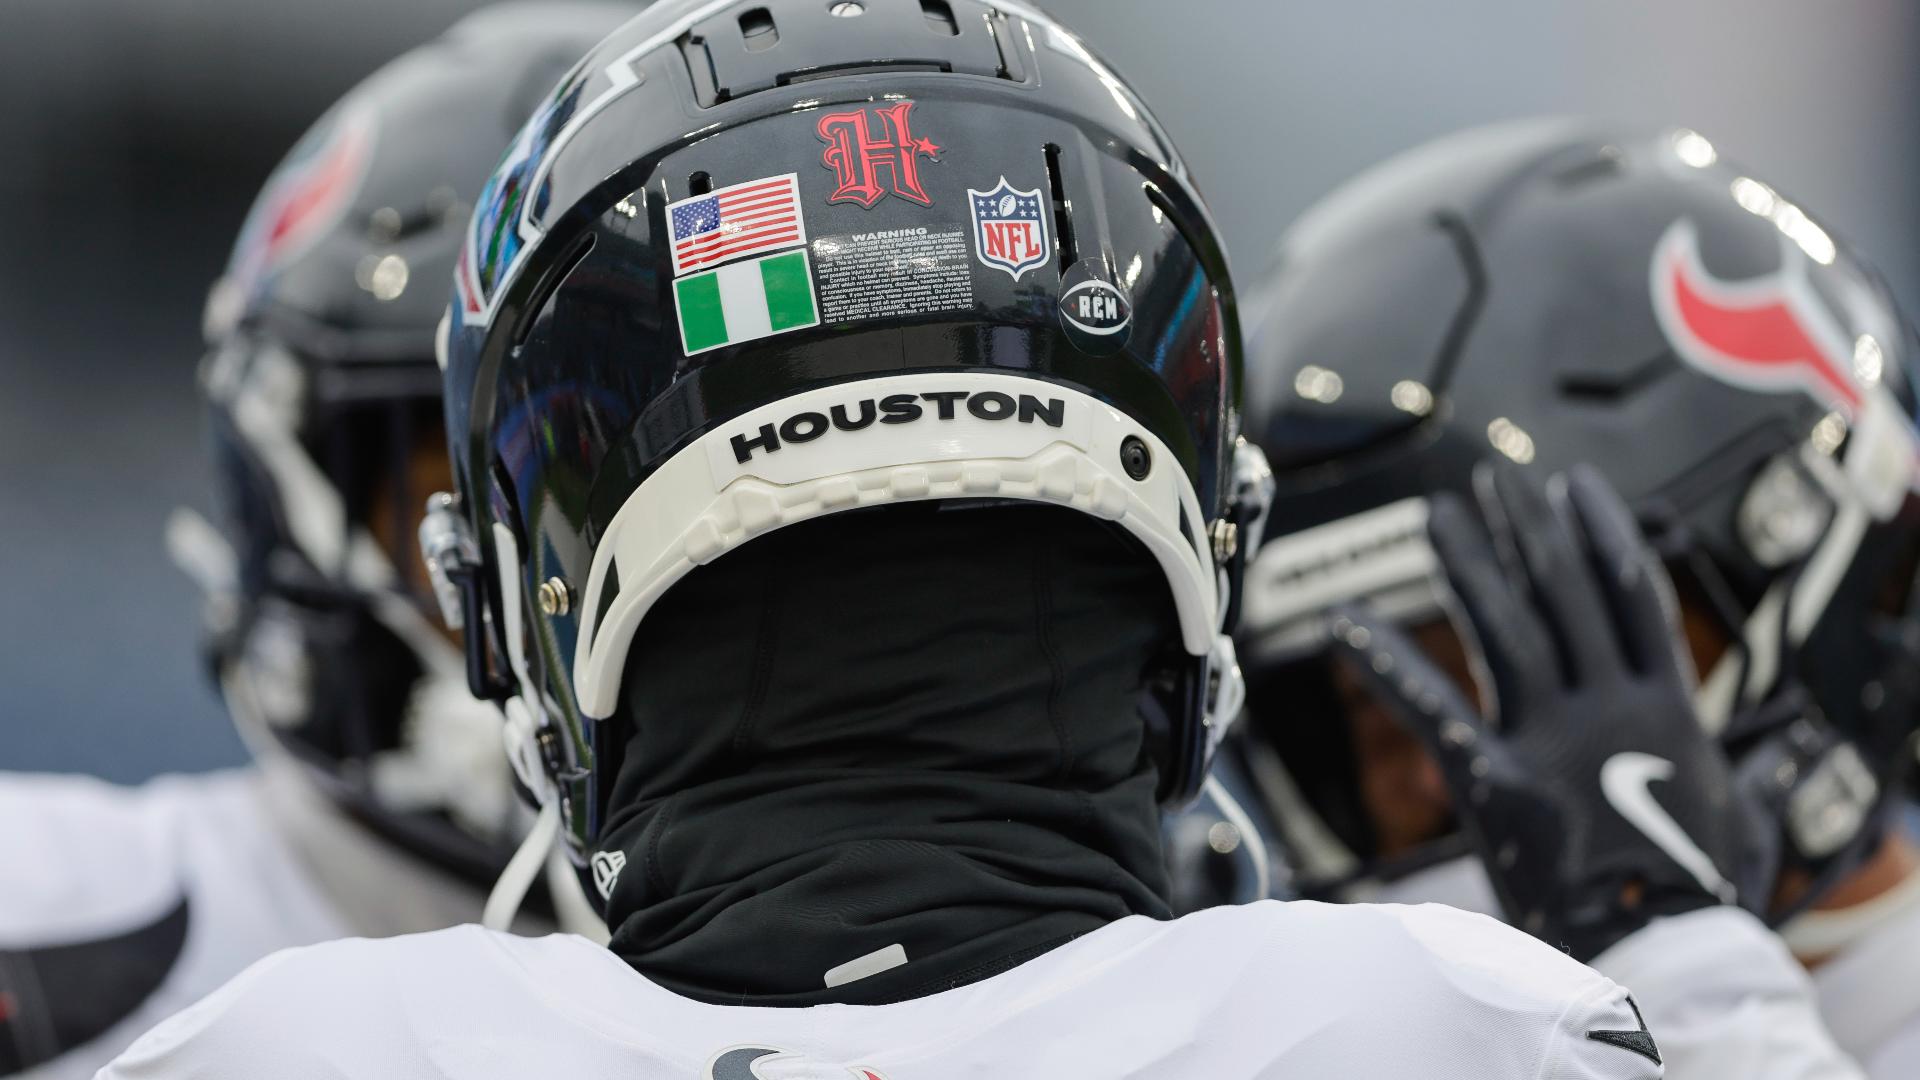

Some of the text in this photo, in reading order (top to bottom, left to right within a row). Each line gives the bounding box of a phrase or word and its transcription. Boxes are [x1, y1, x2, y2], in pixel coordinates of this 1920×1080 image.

[818, 103, 930, 205] H
[852, 228, 927, 241] WARNING
[984, 221, 1040, 264] NFL
[913, 273, 938, 281] Symptoms
[828, 286, 865, 295] consciousness
[903, 284, 931, 293] immediately
[890, 297, 916, 305] symptoms
[872, 304, 907, 312] CLEARANCE.
[1078, 296, 1118, 320] RCM
[730, 392, 1064, 464] HOUSTON
